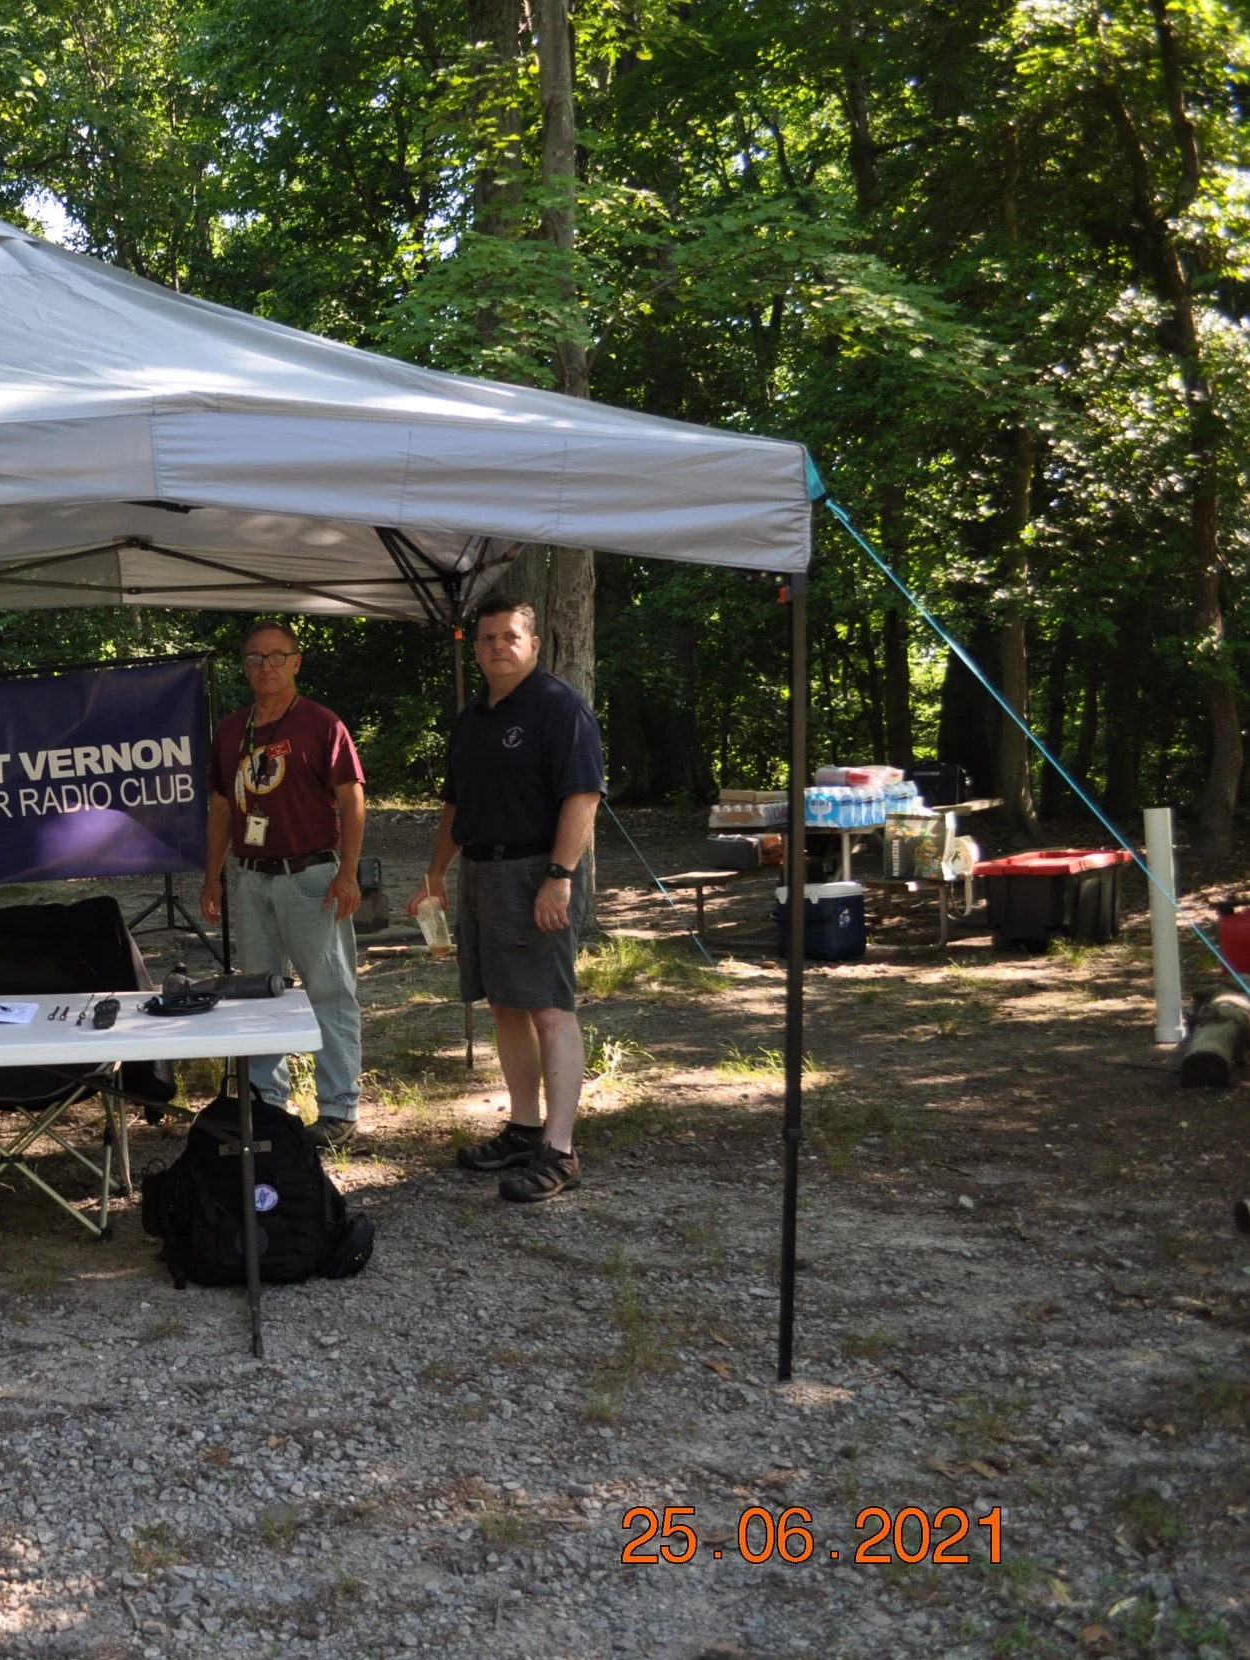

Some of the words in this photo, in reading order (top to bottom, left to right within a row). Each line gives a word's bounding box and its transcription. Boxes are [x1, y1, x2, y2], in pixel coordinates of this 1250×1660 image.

[18, 735, 193, 782] VERNON
[20, 781, 113, 817] RADIO
[119, 773, 196, 807] CLUB
